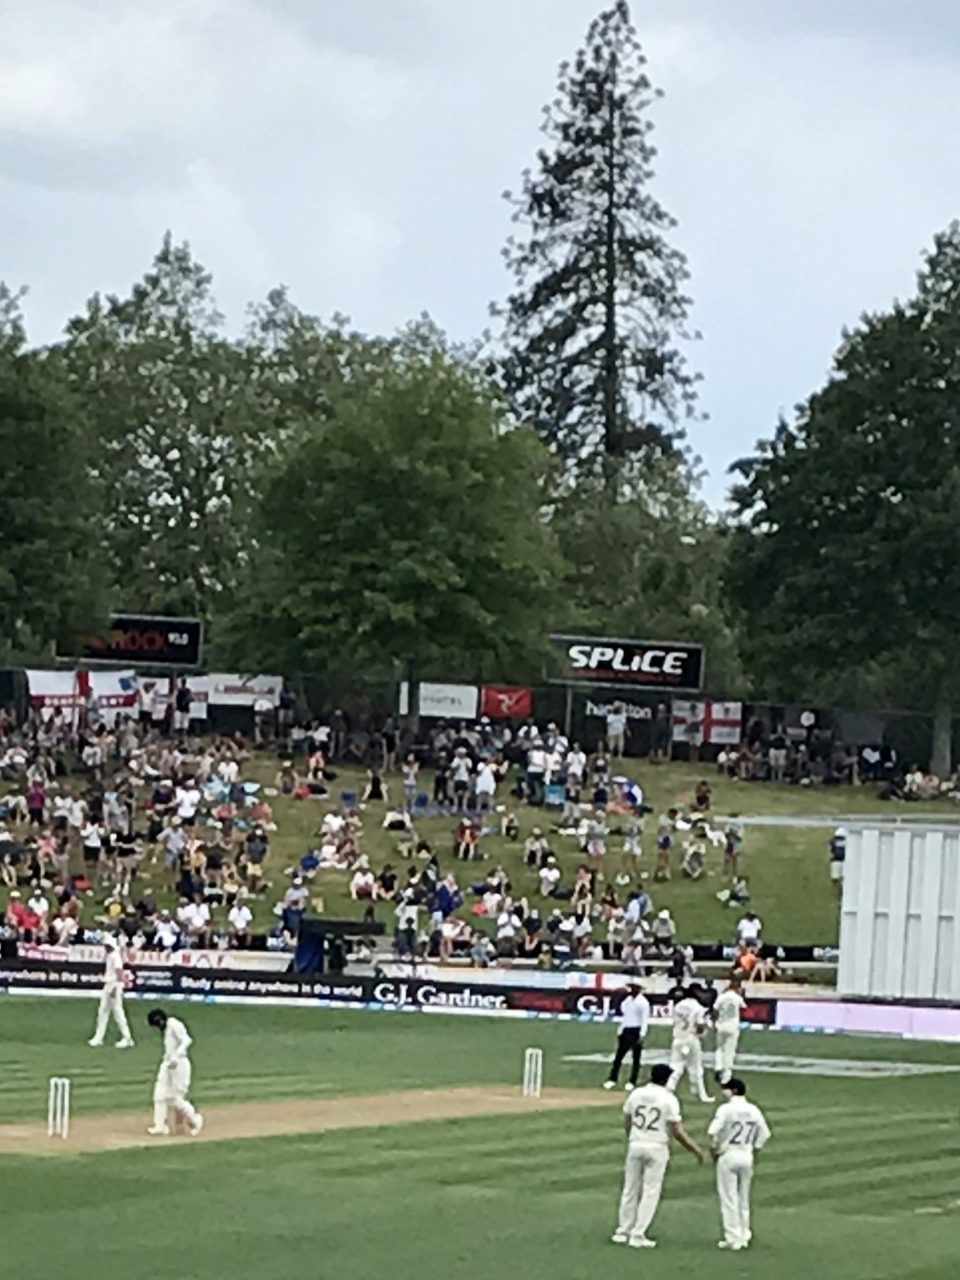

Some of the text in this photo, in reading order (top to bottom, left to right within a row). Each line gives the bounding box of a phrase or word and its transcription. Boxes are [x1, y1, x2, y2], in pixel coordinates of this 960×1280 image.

[248, 981, 299, 994] anywhere
[313, 982, 330, 995] the
[633, 1104, 662, 1131] 52
[729, 1120, 757, 1145] 27
